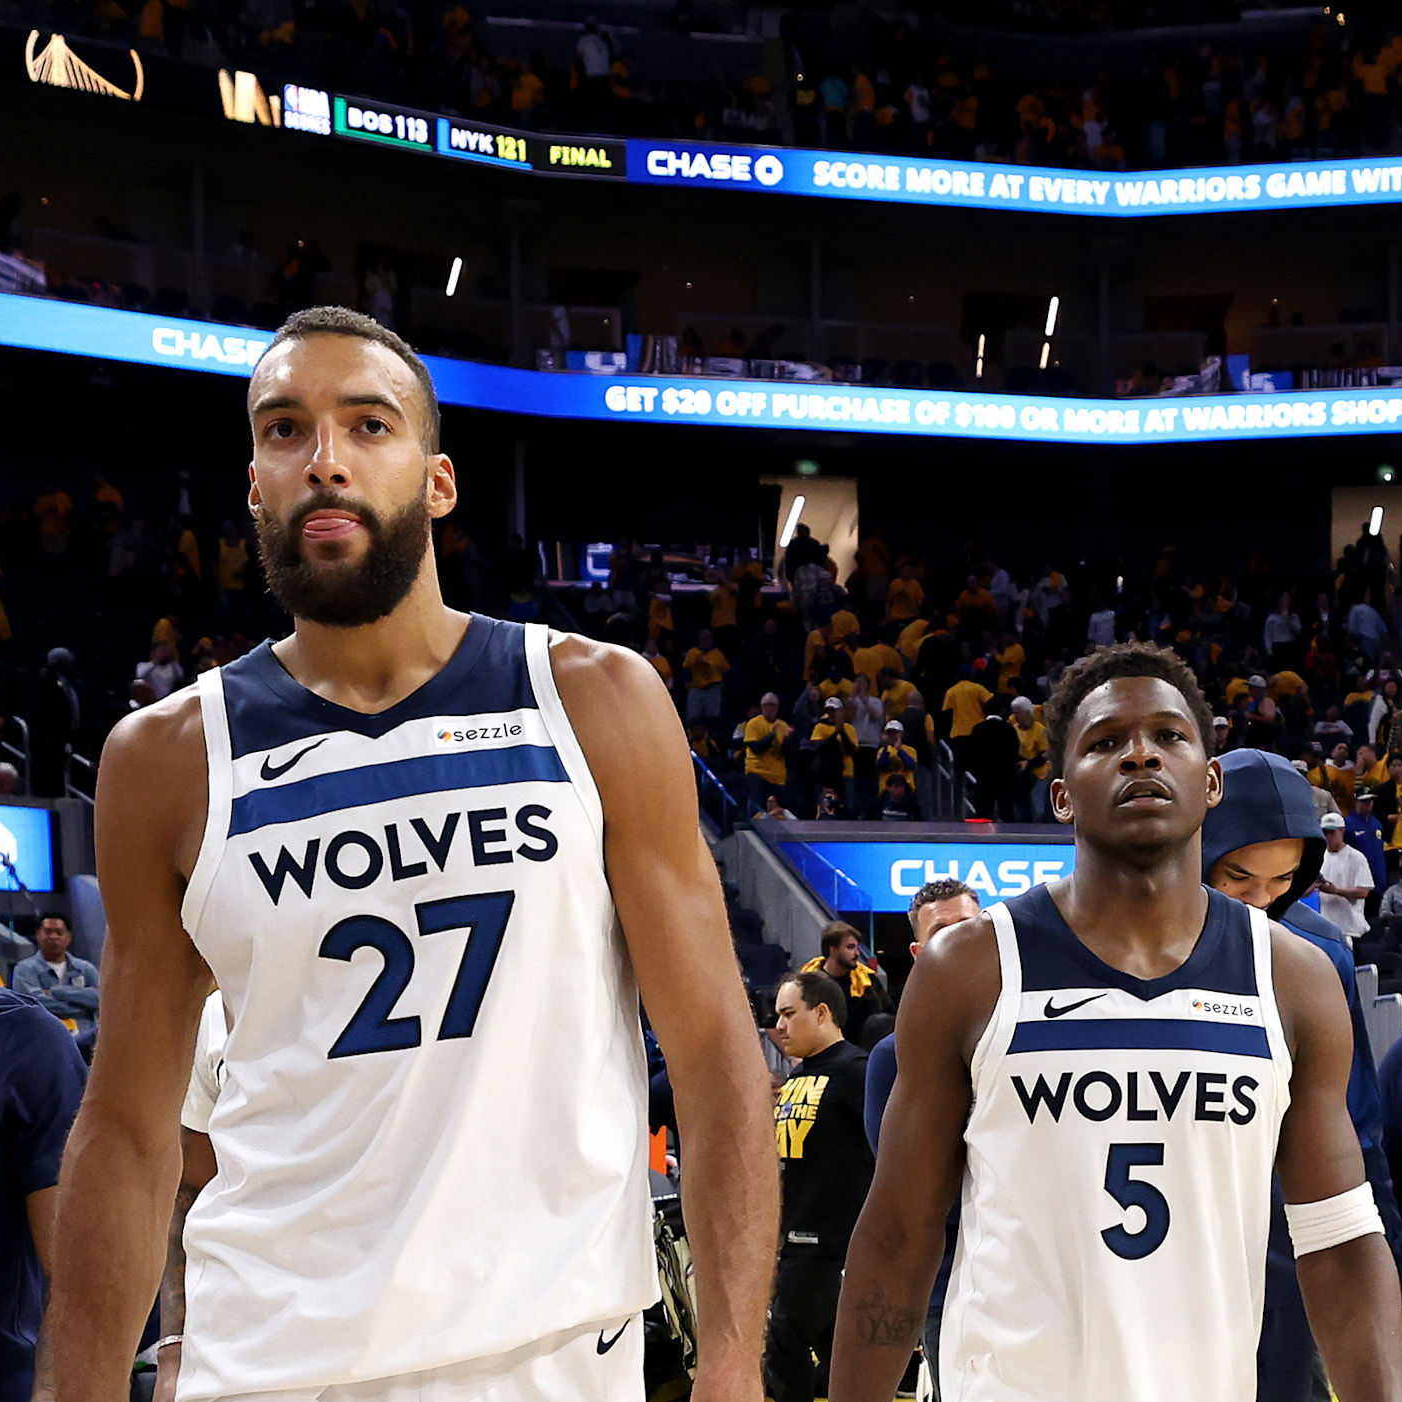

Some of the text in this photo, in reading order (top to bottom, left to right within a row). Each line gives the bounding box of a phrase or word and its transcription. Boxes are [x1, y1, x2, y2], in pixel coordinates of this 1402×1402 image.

[347, 107, 394, 134] BOS
[451, 128, 527, 162] NYK 121
[549, 145, 612, 168] FINAL
[647, 150, 752, 181] CHASE
[813, 160, 900, 191] SCORE
[906, 167, 984, 196] MORE
[989, 173, 1024, 199] AT
[1029, 175, 1110, 205] EVERY
[1115, 174, 1261, 206] WARRIORS
[1266, 169, 1346, 199] GAME
[152, 327, 267, 366] CHASE
[605, 385, 659, 412] GET
[661, 388, 711, 415] $20
[716, 391, 767, 417] OFF
[772, 392, 910, 424] PURCHASE
[915, 400, 950, 426] OF
[1020, 405, 1059, 431] OR
[1064, 407, 1139, 433] MORE
[1143, 408, 1178, 433] AT
[1183, 401, 1326, 431] WARRIORS
[453, 722, 523, 742] sezzle
[247, 804, 558, 906] WOLVES
[891, 859, 1064, 896] CHASE
[318, 890, 515, 1059] 27
[1203, 1001, 1254, 1017] sezzle
[790, 1104, 818, 1120] THE
[1010, 1070, 1260, 1126] WOLVES
[774, 1119, 815, 1158] AY
[1100, 1142, 1171, 1260] 5
